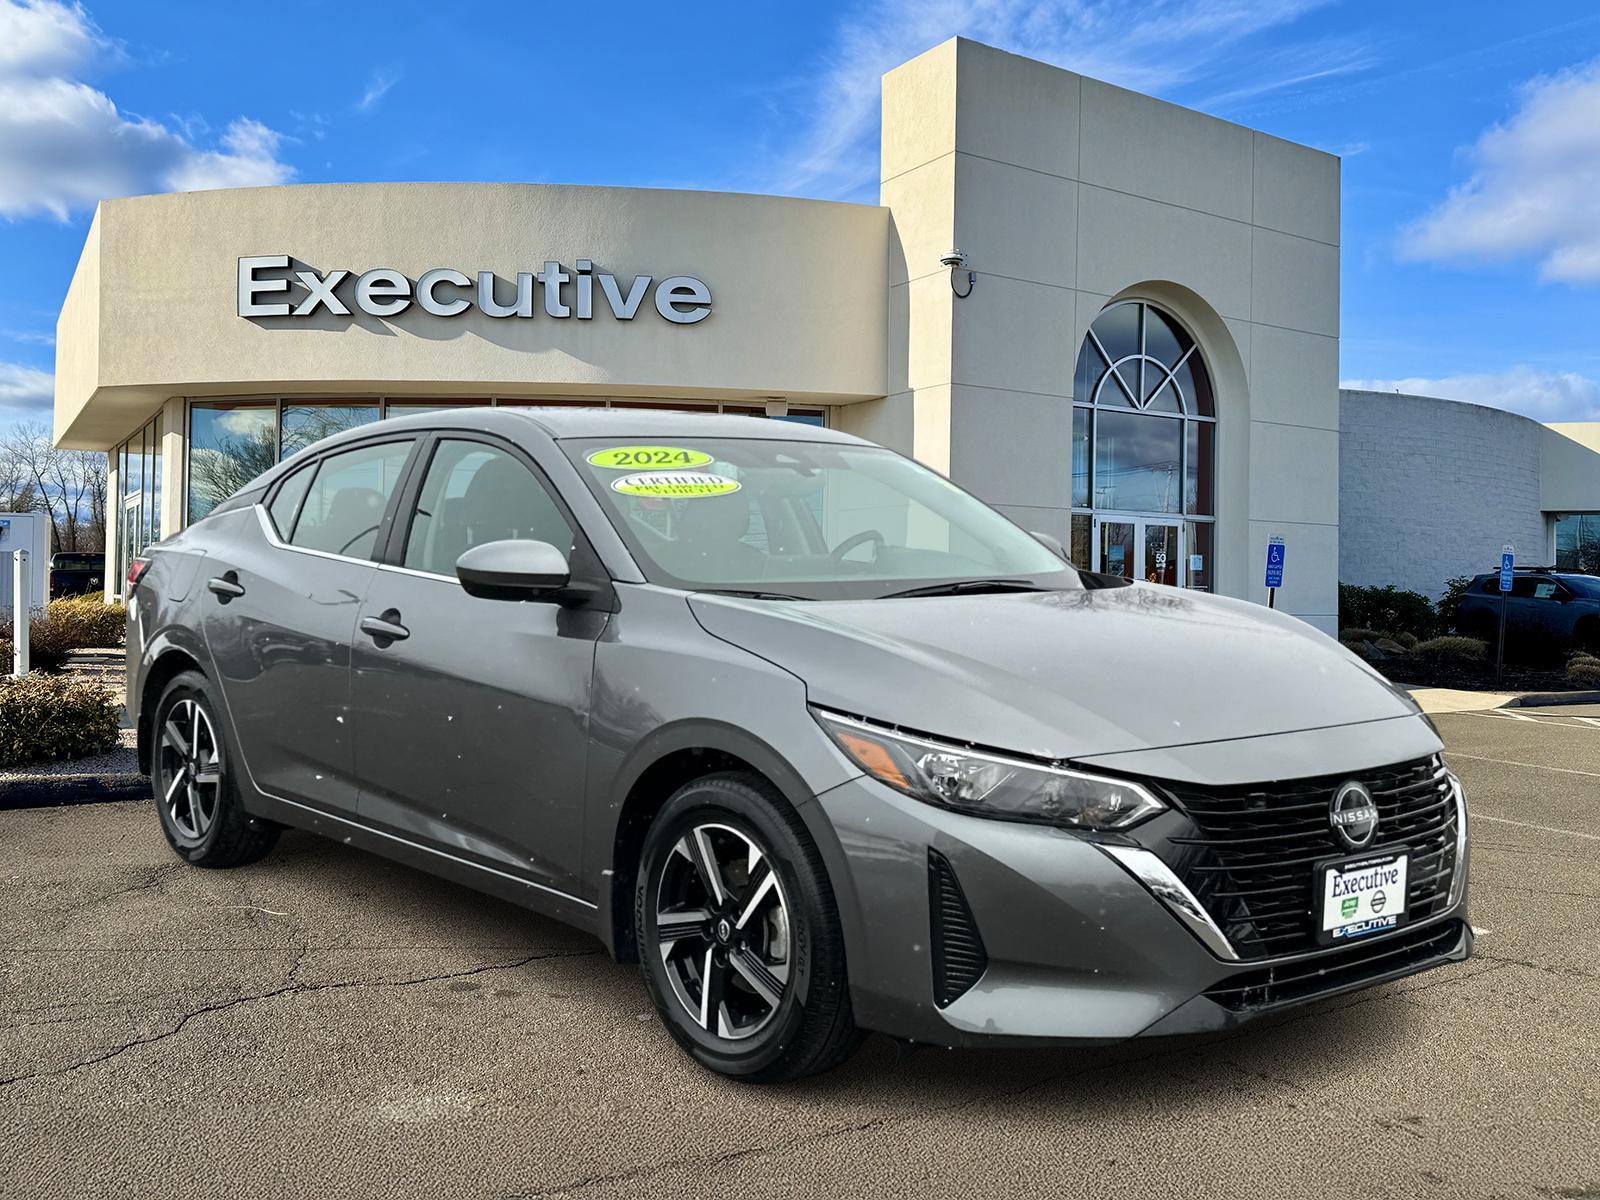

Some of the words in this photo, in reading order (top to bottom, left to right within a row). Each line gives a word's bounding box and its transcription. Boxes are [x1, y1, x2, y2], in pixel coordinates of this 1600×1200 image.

[236, 254, 713, 325] Executive
[613, 451, 693, 466] 2024
[1333, 808, 1377, 824] NISSAN
[1331, 864, 1399, 898] Executive
[1332, 915, 1397, 938] EXECUTIVE
